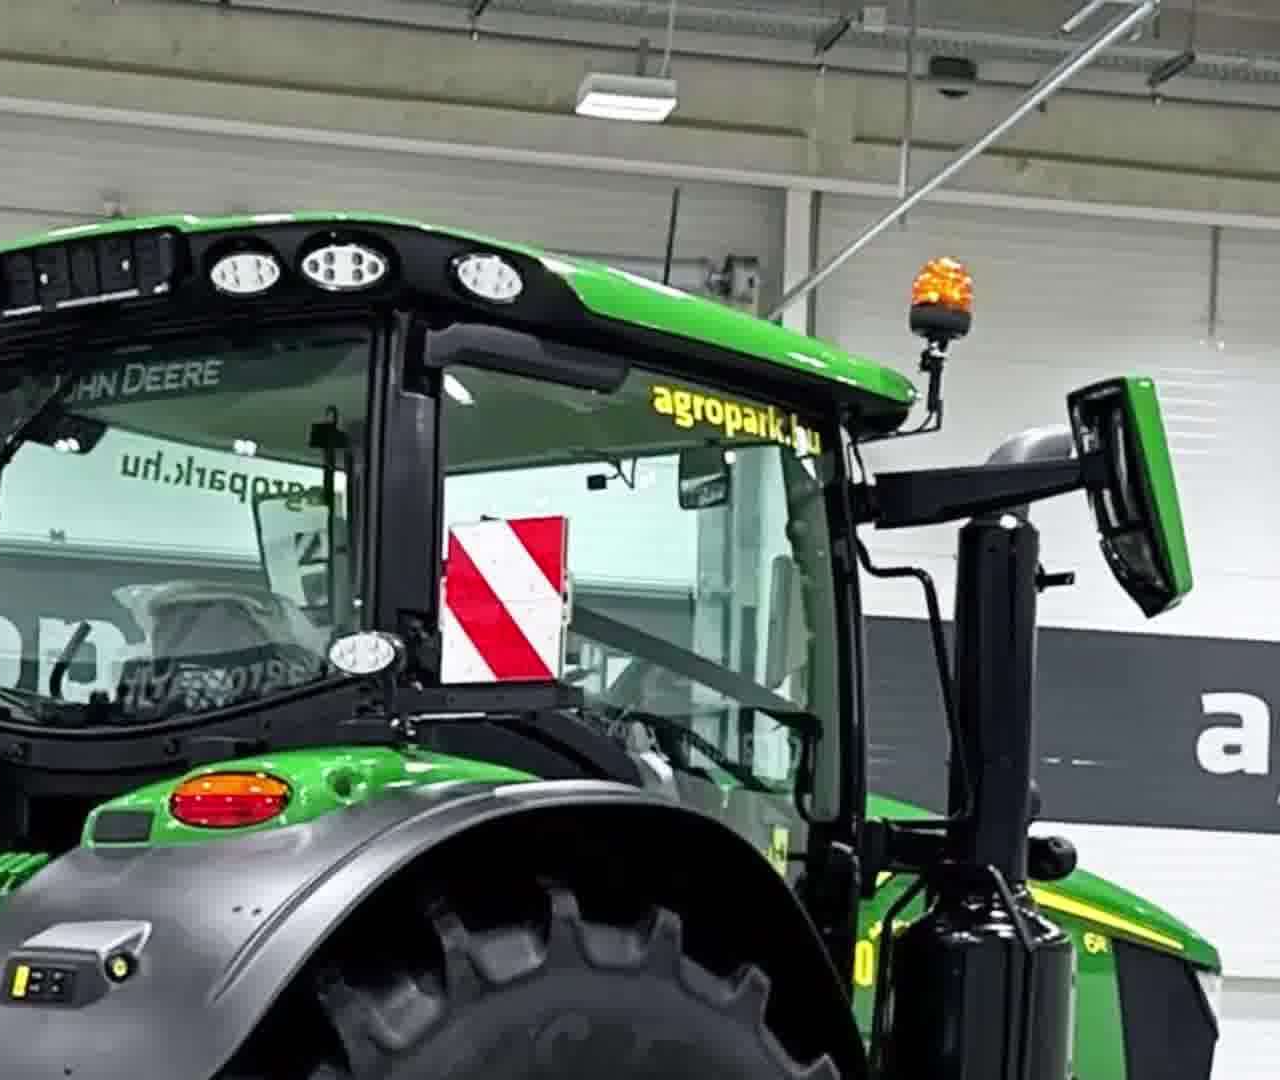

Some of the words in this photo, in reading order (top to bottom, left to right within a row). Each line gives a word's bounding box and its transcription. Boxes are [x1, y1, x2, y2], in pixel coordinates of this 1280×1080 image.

[48, 371, 119, 402] JHN
[121, 360, 224, 396] DEERE
[652, 385, 821, 456] agropark.hu
